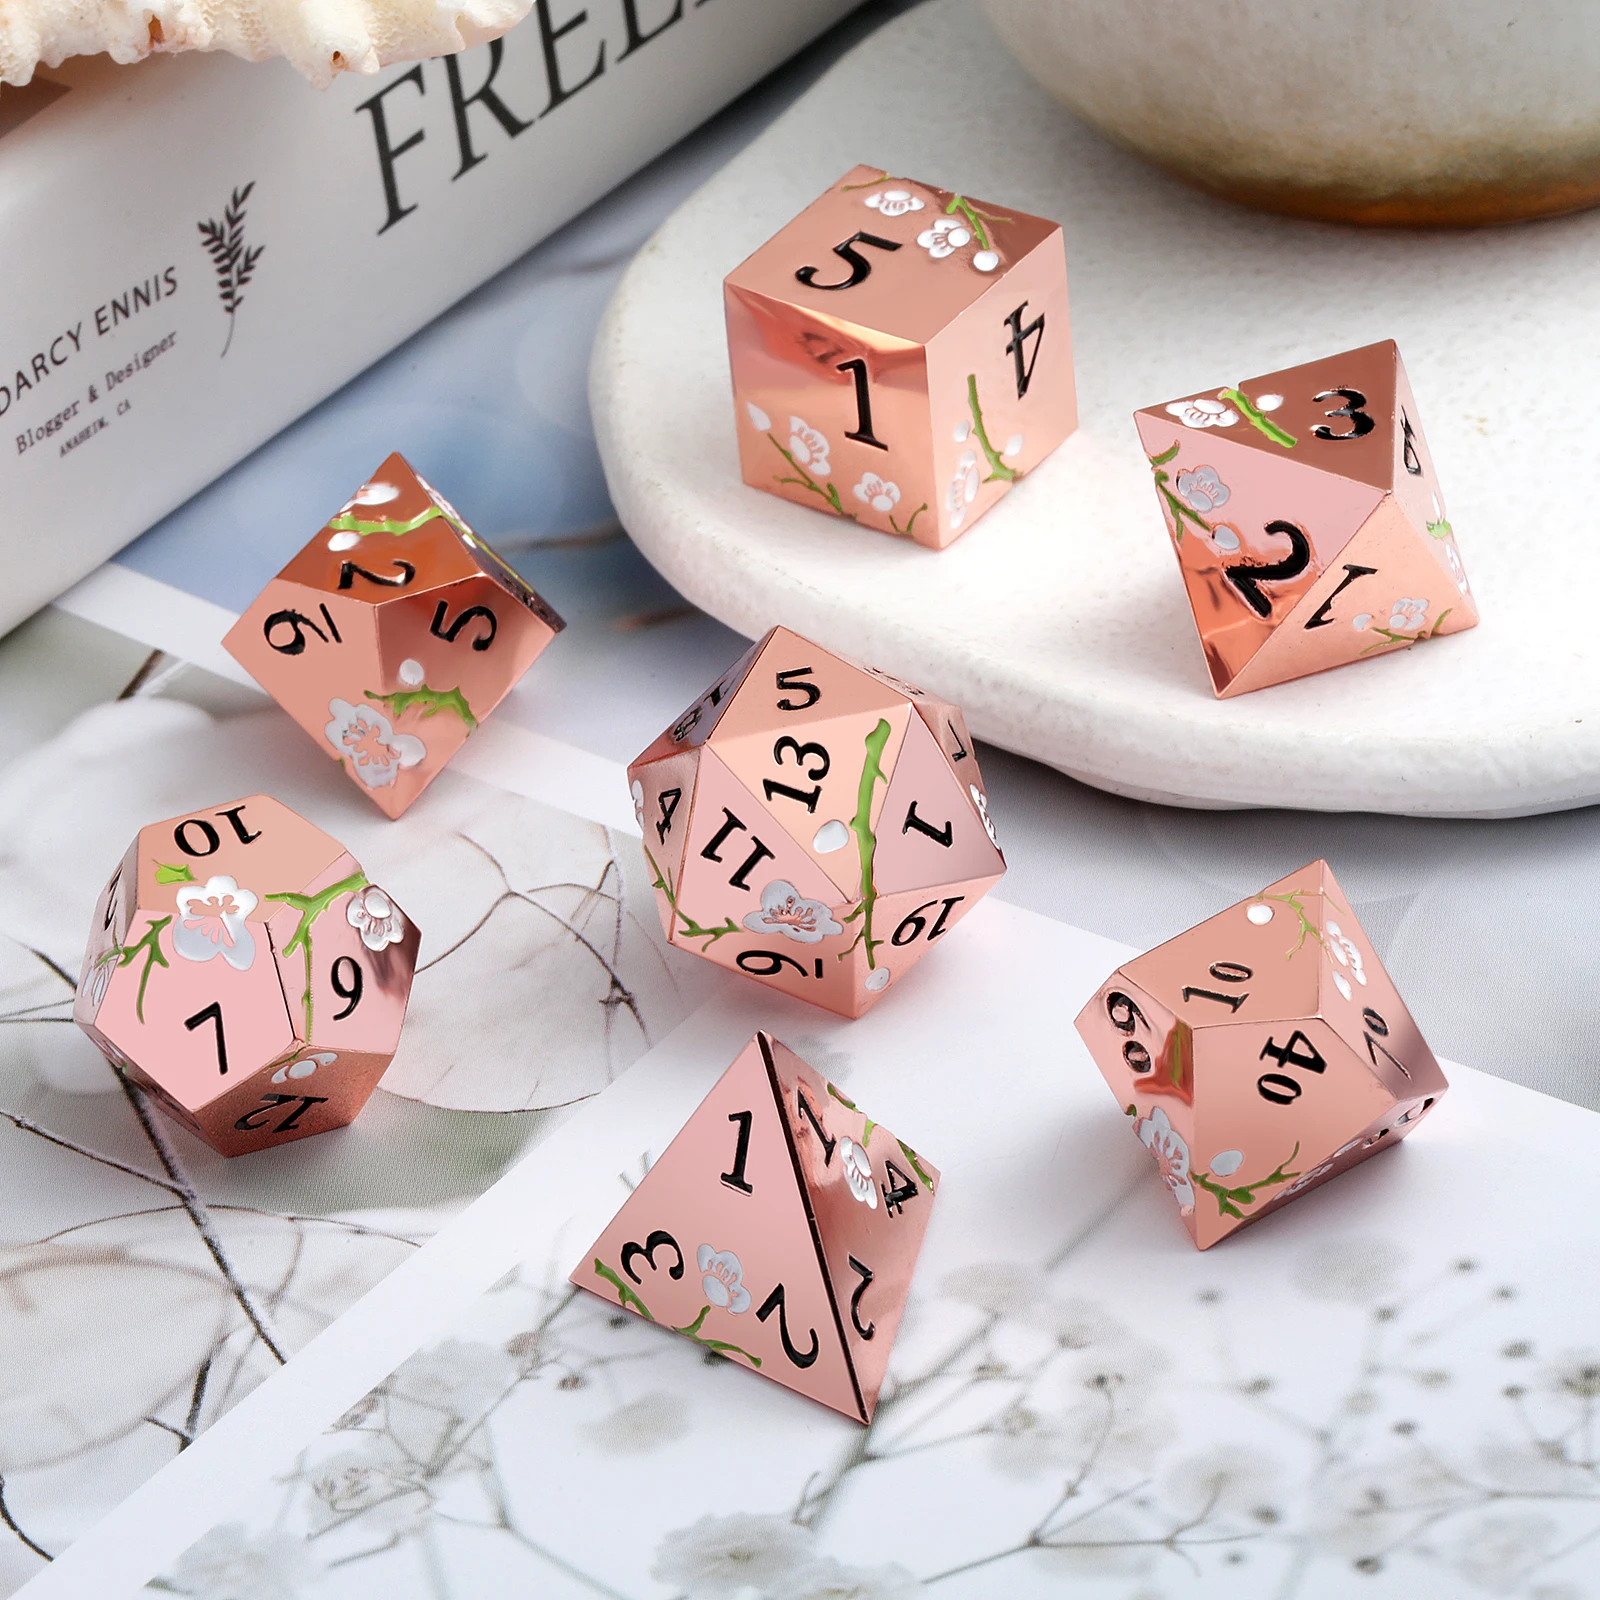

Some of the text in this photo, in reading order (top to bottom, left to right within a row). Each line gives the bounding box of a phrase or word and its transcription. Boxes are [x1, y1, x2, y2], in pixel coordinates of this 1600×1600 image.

[355, 0, 707, 236] FRE
[795, 230, 903, 291] 5
[94, 266, 178, 336] ENNIS
[1003, 300, 1046, 400] 4
[16, 331, 177, 455] Blogger & Designer
[116, 399, 132, 416] CA
[836, 358, 889, 452] 1
[1312, 389, 1376, 441] 3
[1224, 520, 1310, 620] 2
[1303, 563, 1379, 630] 1
[430, 600, 498, 652] 5
[776, 666, 822, 712] 5
[762, 735, 831, 814] 13
[174, 805, 263, 857] 10
[656, 787, 682, 845] 4
[700, 806, 776, 891] 11
[902, 800, 954, 848] 1
[1181, 961, 1253, 1014] 10
[184, 1001, 229, 1076] 7
[1257, 1030, 1328, 1106] 40
[720, 1110, 754, 1197] 1
[797, 1089, 837, 1168] 1
[881, 1159, 919, 1219] 4
[620, 1229, 685, 1286] 3
[755, 1283, 820, 1369] 2
[848, 1253, 876, 1341] 2
